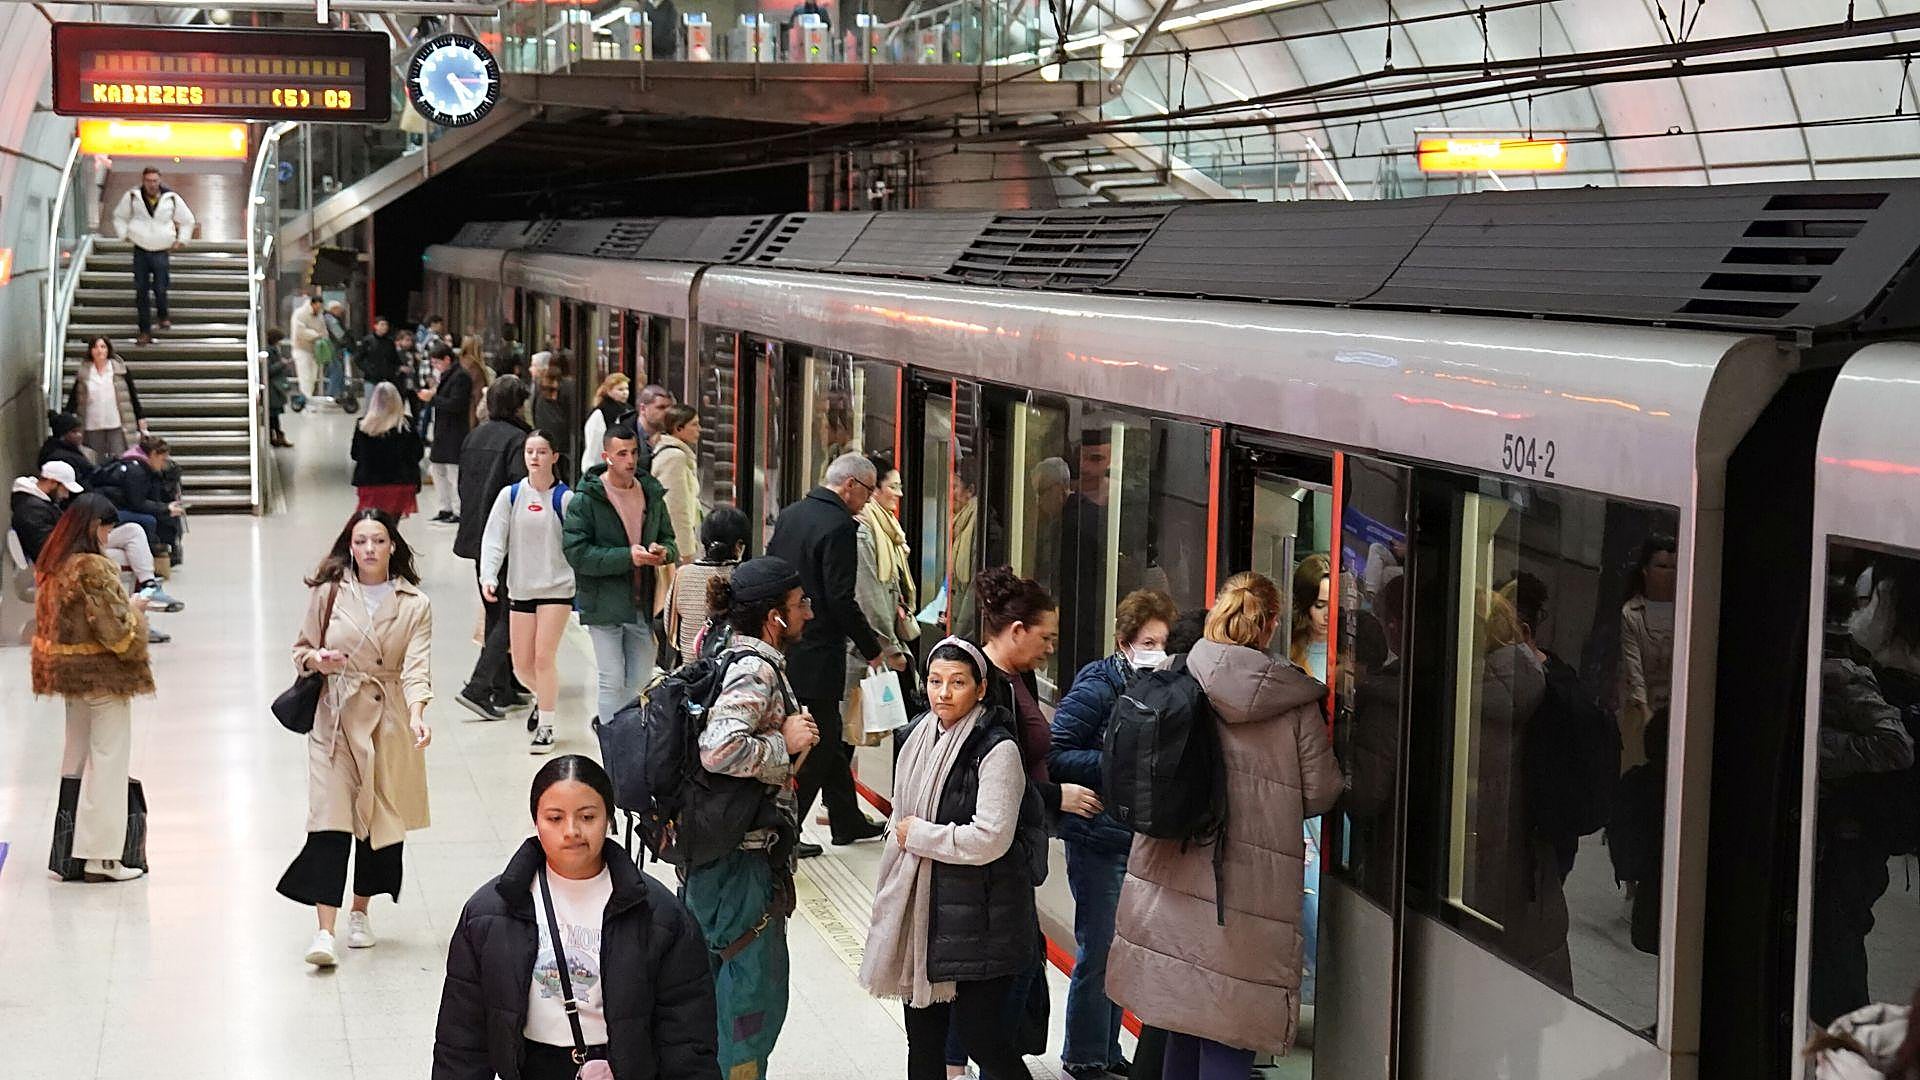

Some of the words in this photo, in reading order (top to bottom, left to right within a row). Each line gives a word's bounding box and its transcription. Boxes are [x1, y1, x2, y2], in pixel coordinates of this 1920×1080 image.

[93, 83, 203, 105] KABIEZES
[272, 88, 310, 107] (5)
[324, 89, 351, 109] 03
[1502, 433, 1555, 478] 504-2
